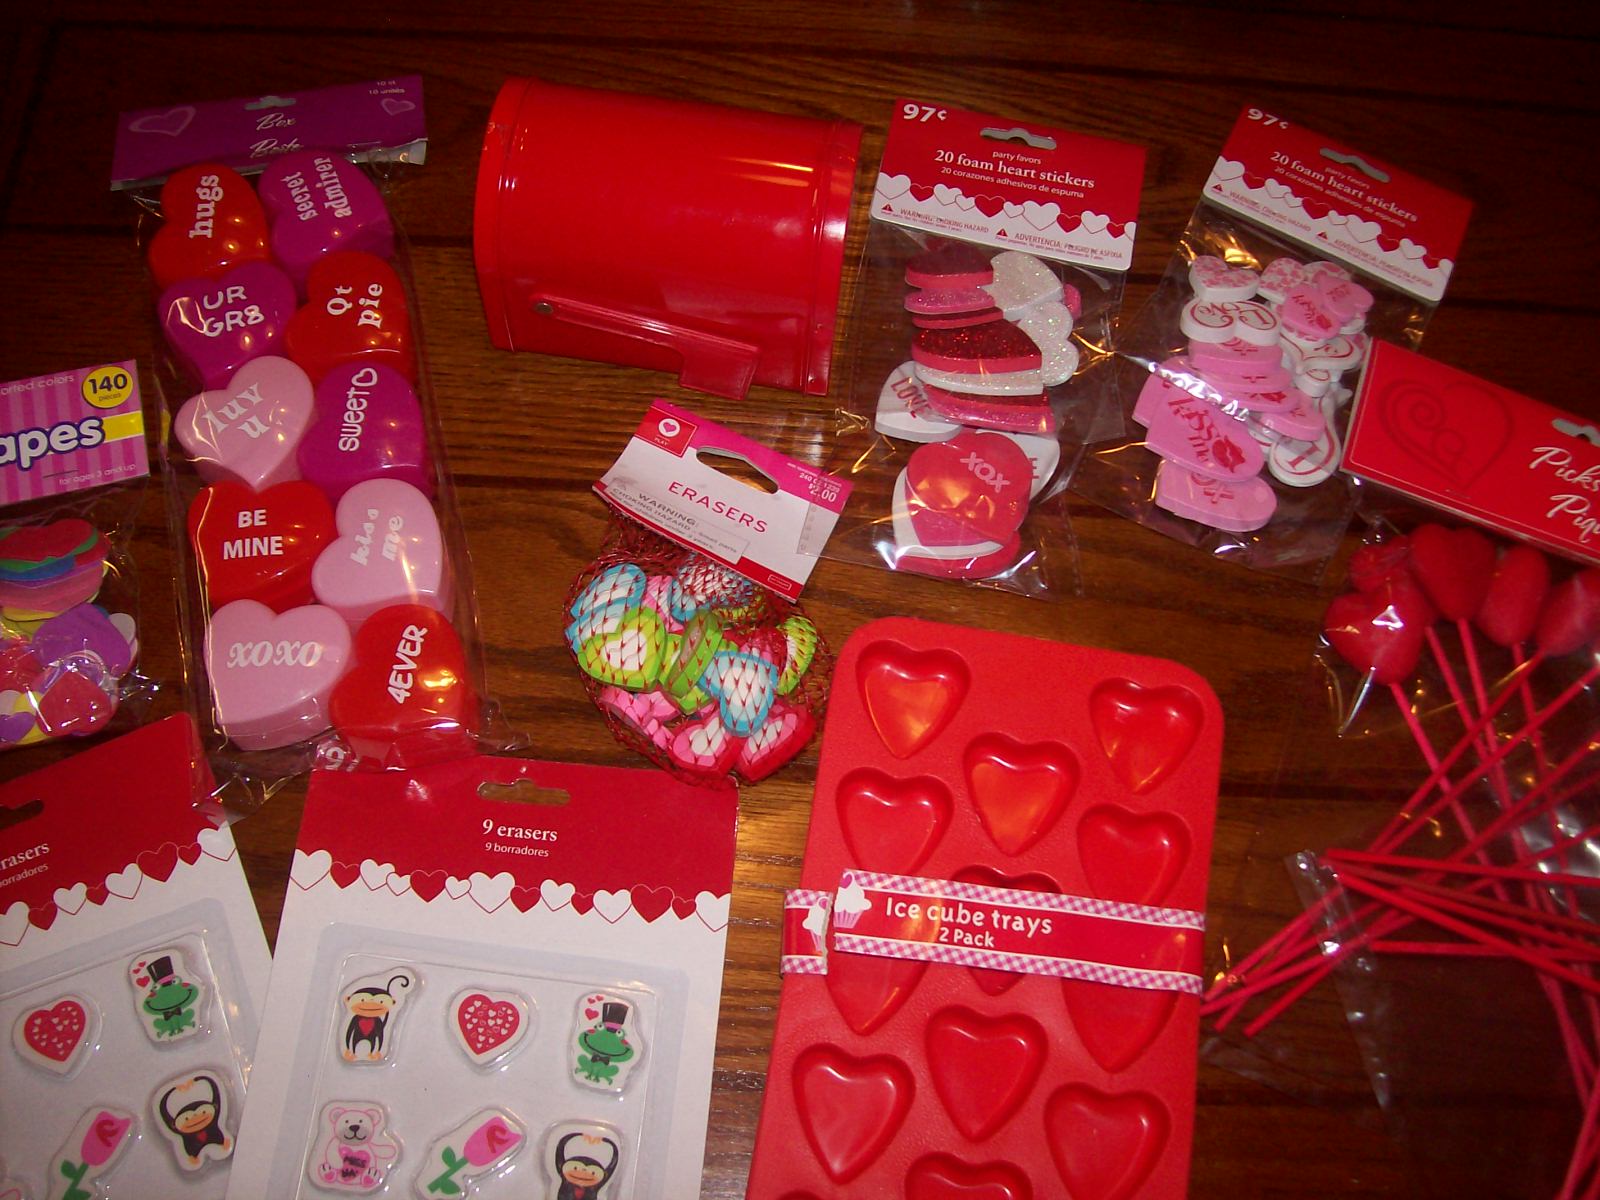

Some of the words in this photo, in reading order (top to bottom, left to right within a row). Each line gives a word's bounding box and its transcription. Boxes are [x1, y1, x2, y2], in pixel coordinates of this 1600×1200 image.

[256, 112, 297, 131] Box
[902, 103, 949, 122] 97¢
[1246, 107, 1290, 130] 97¢
[934, 149, 955, 163] 20
[956, 153, 994, 172] foam
[997, 160, 1037, 179] heart
[1038, 171, 1095, 189] stickers
[992, 150, 1016, 162] party
[1016, 153, 1042, 165] favors
[280, 171, 320, 222] secret
[313, 156, 353, 220] admirer
[940, 166, 952, 175] 20
[952, 169, 995, 184] corazones
[996, 177, 1038, 191] adhesivos
[1038, 184, 1050, 193] de
[1050, 187, 1085, 200] espuma
[1270, 151, 1290, 166] 20
[1290, 160, 1325, 183] foam
[1327, 175, 1366, 199] heart
[1366, 194, 1419, 223] stickers
[188, 174, 225, 240] hugs
[326, 284, 353, 316] Qt
[357, 283, 384, 329] pie
[204, 304, 265, 338] GR8
[38, 374, 75, 388] colors
[88, 373, 128, 395] 140
[201, 382, 264, 434] luv
[0, 418, 104, 469] apes
[236, 414, 271, 439] u
[612, 487, 654, 514] CHOKING
[654, 508, 692, 531] HAZARD
[668, 480, 769, 534] ERASERS
[808, 483, 838, 503] $2.00
[238, 509, 267, 528] BE
[223, 535, 284, 561] MINE
[382, 514, 405, 562] me
[387, 623, 429, 704] 4EVER
[482, 818, 494, 835] 9
[496, 825, 558, 842] erasers
[485, 841, 492, 851] 9
[493, 842, 550, 858] borradores
[886, 896, 922, 920] Ice
[926, 902, 986, 928] cube
[991, 909, 1053, 939] trays
[938, 926, 950, 942] 2
[953, 928, 995, 948] Pack
